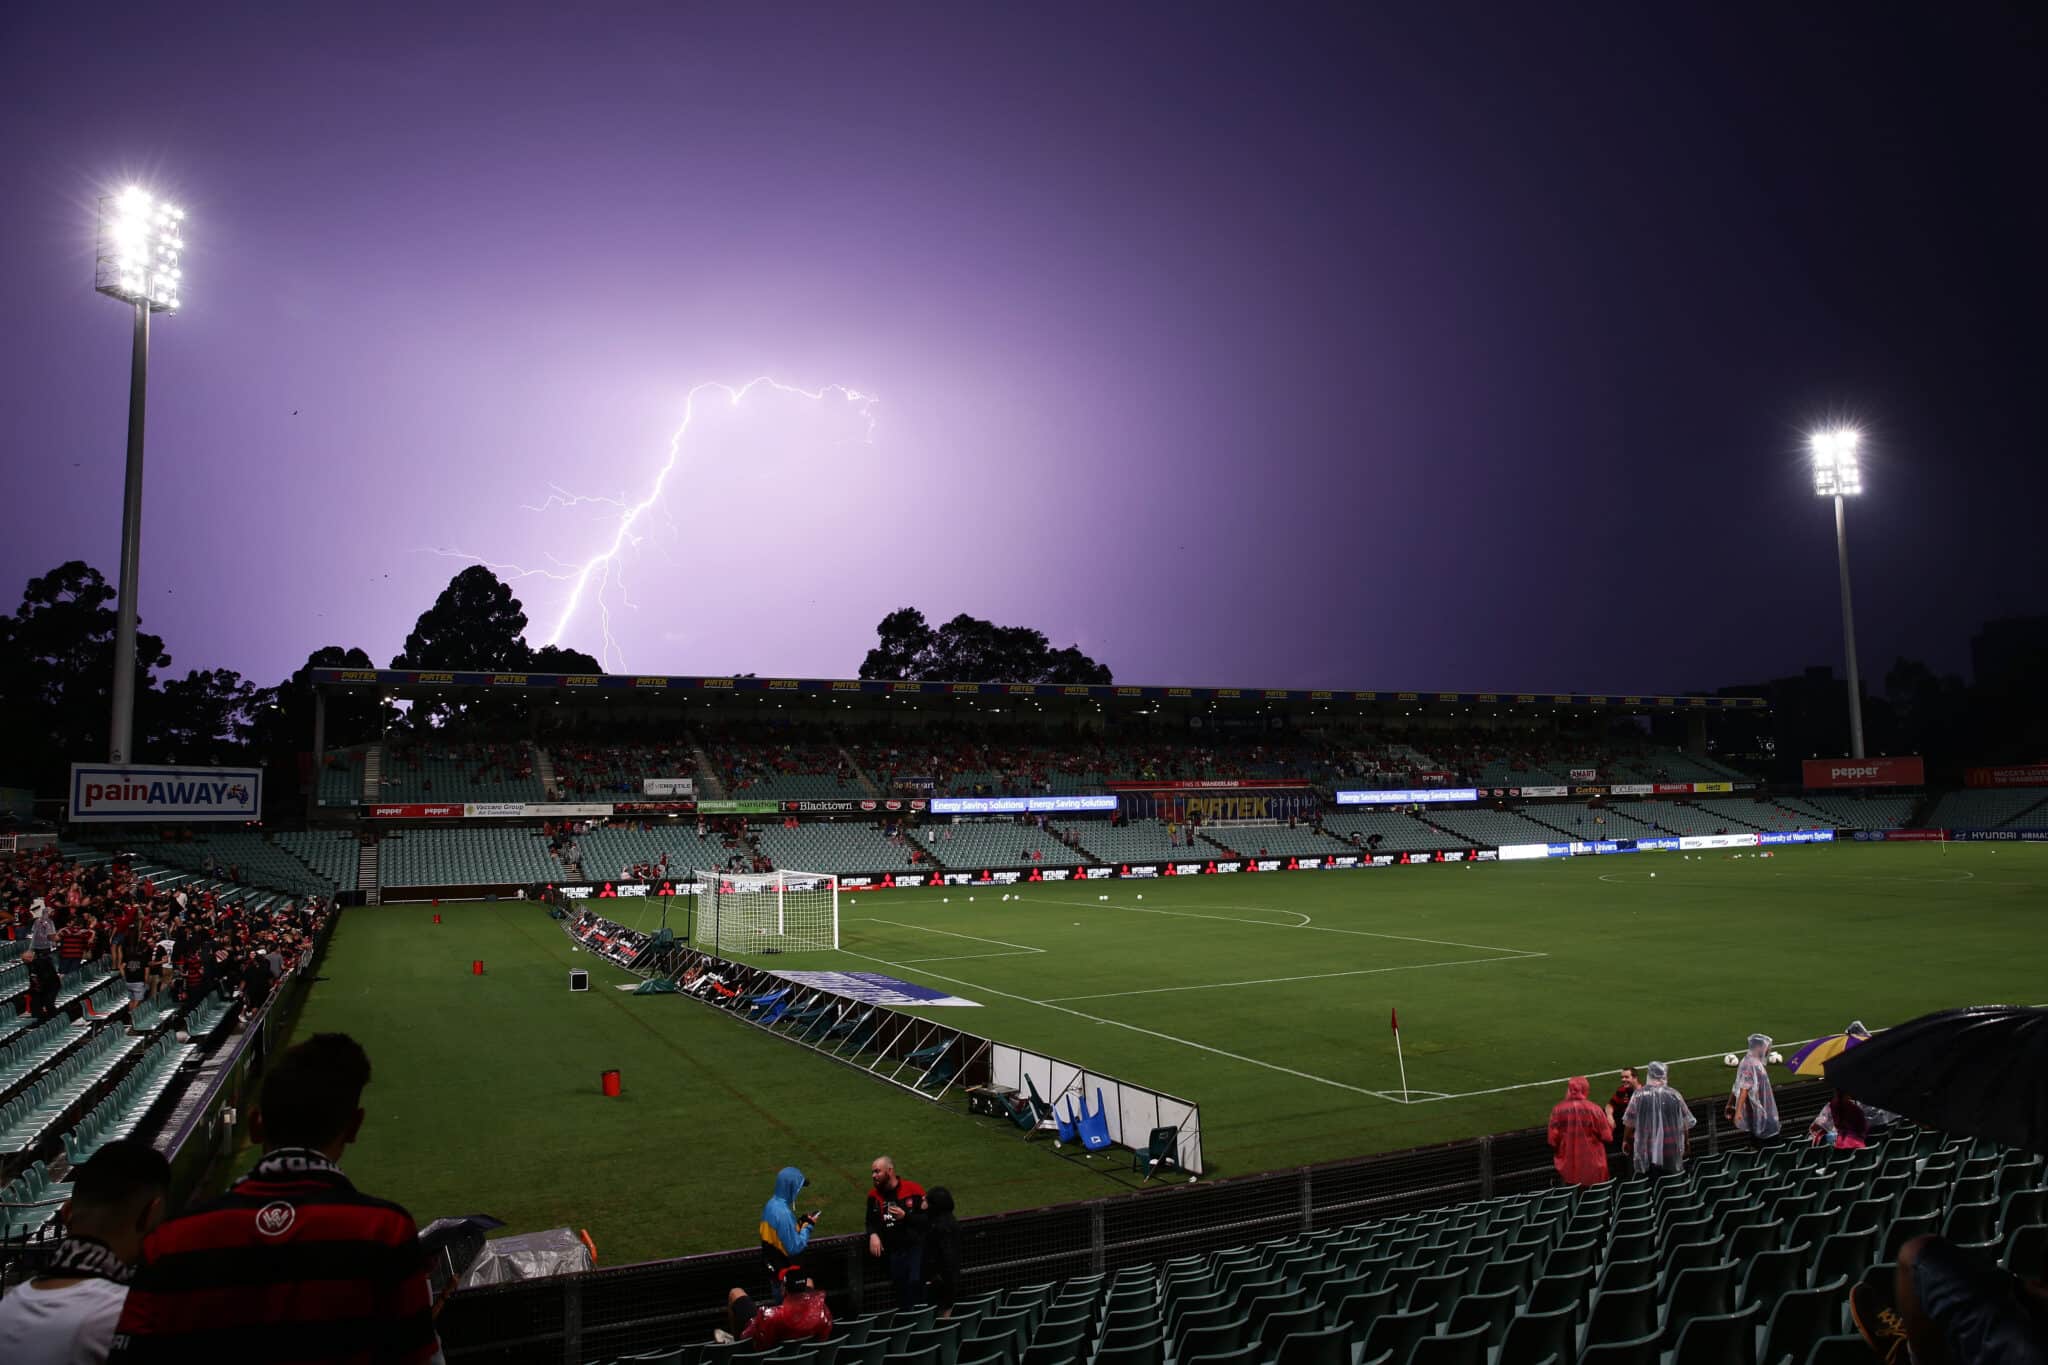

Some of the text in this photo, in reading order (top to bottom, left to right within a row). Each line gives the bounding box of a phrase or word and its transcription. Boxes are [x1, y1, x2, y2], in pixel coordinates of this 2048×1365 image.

[340, 671, 376, 680] PIRTEK
[419, 673, 453, 682] PIRTEK
[494, 674, 527, 683] PIRTEK
[567, 676, 599, 684] PIRTEK
[636, 677, 668, 686] PIRTEK
[704, 679, 735, 687] PIRTEK
[769, 680, 799, 688] PIRTEK
[832, 681, 861, 689] PIRTEK
[1832, 767, 1879, 779] pepper
[86, 778, 228, 807] painAWAY
[800, 801, 852, 811] Blacktown
[934, 801, 961, 811] Energy
[962, 801, 987, 811] Saving
[990, 801, 1024, 809] Solutions
[1029, 799, 1055, 809] Energy
[1056, 799, 1080, 808] Saving
[1081, 798, 1114, 807] Solutions
